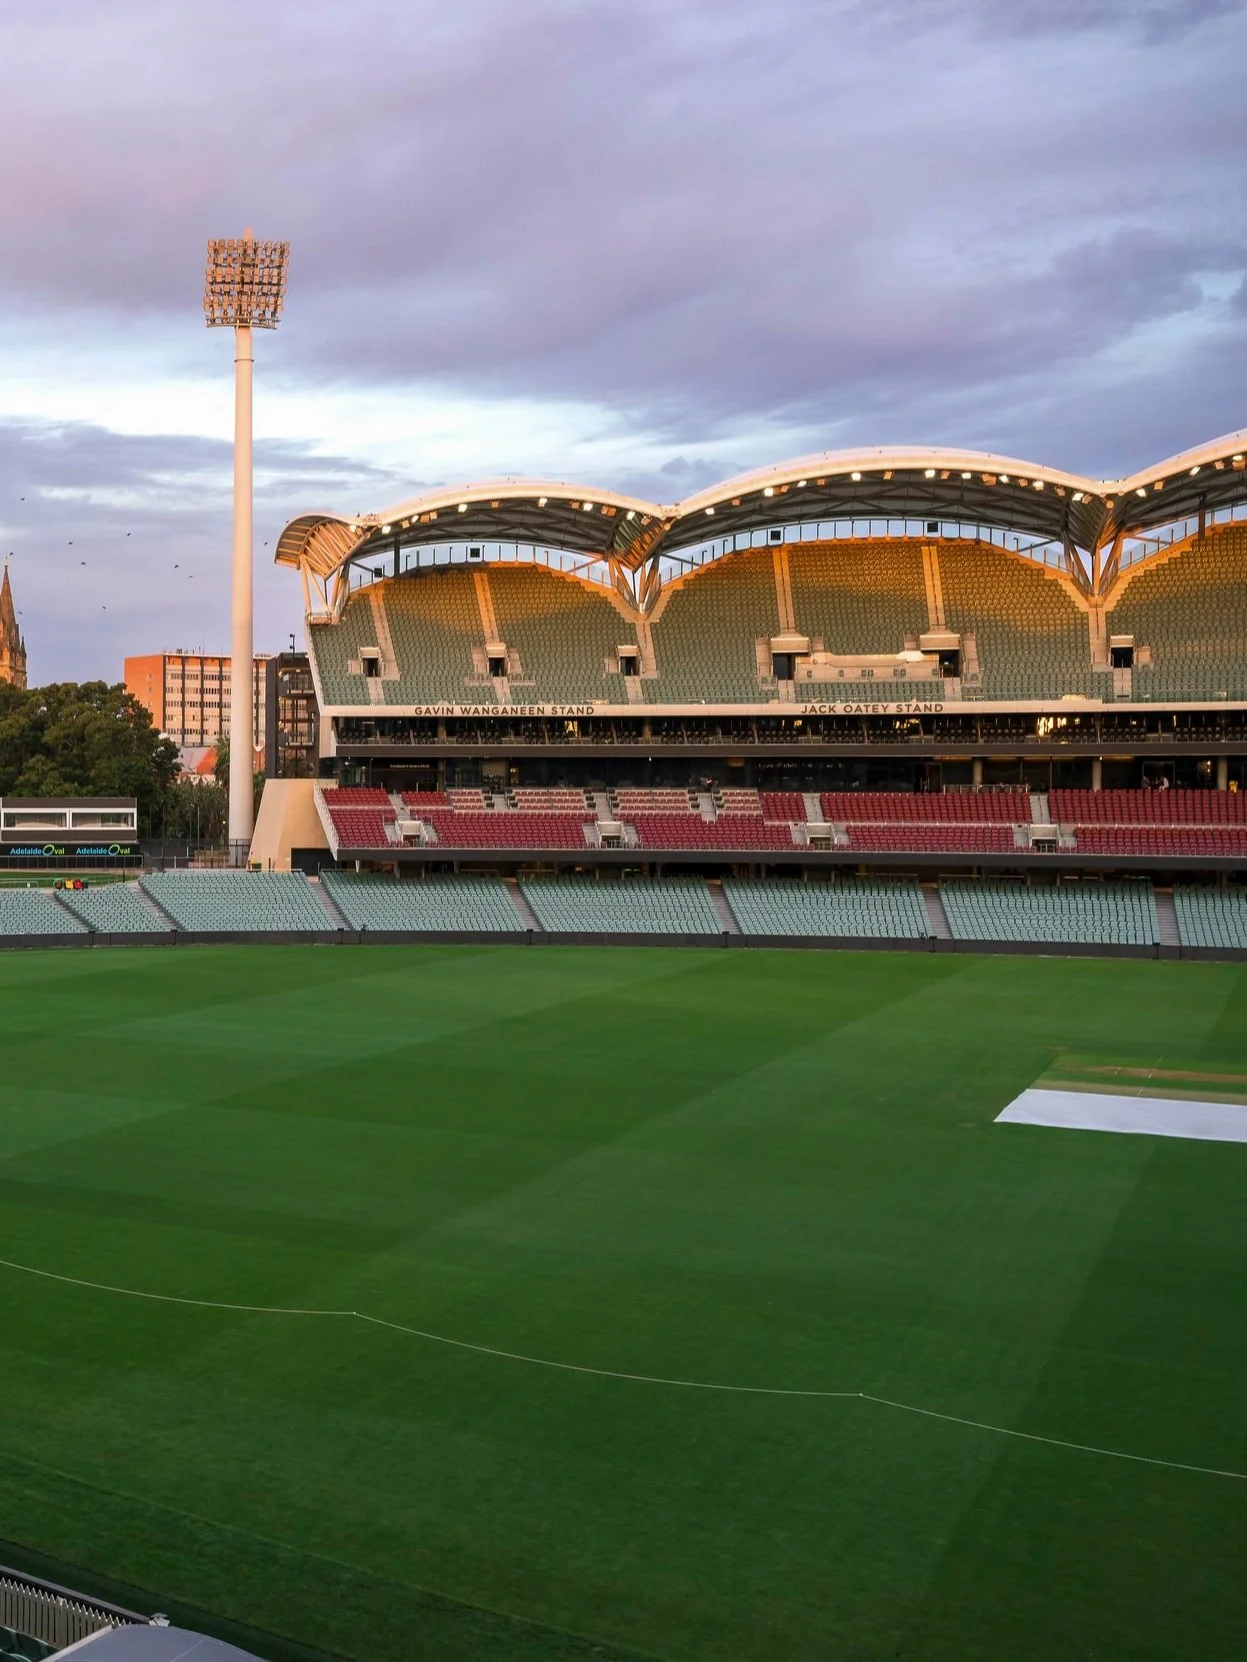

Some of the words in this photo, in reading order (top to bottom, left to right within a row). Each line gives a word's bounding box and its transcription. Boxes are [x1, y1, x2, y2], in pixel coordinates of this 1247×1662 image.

[414, 706, 454, 715] GAVIN
[460, 706, 545, 715] WANGANEEN
[551, 706, 595, 715] STAND
[801, 704, 837, 714] JACK
[843, 704, 890, 713] OATEY
[896, 703, 944, 713] STAND
[10, 847, 42, 855] Adelaide
[42, 844, 65, 856] Oval
[76, 847, 108, 855] Adelaide
[108, 844, 131, 856] Oval
